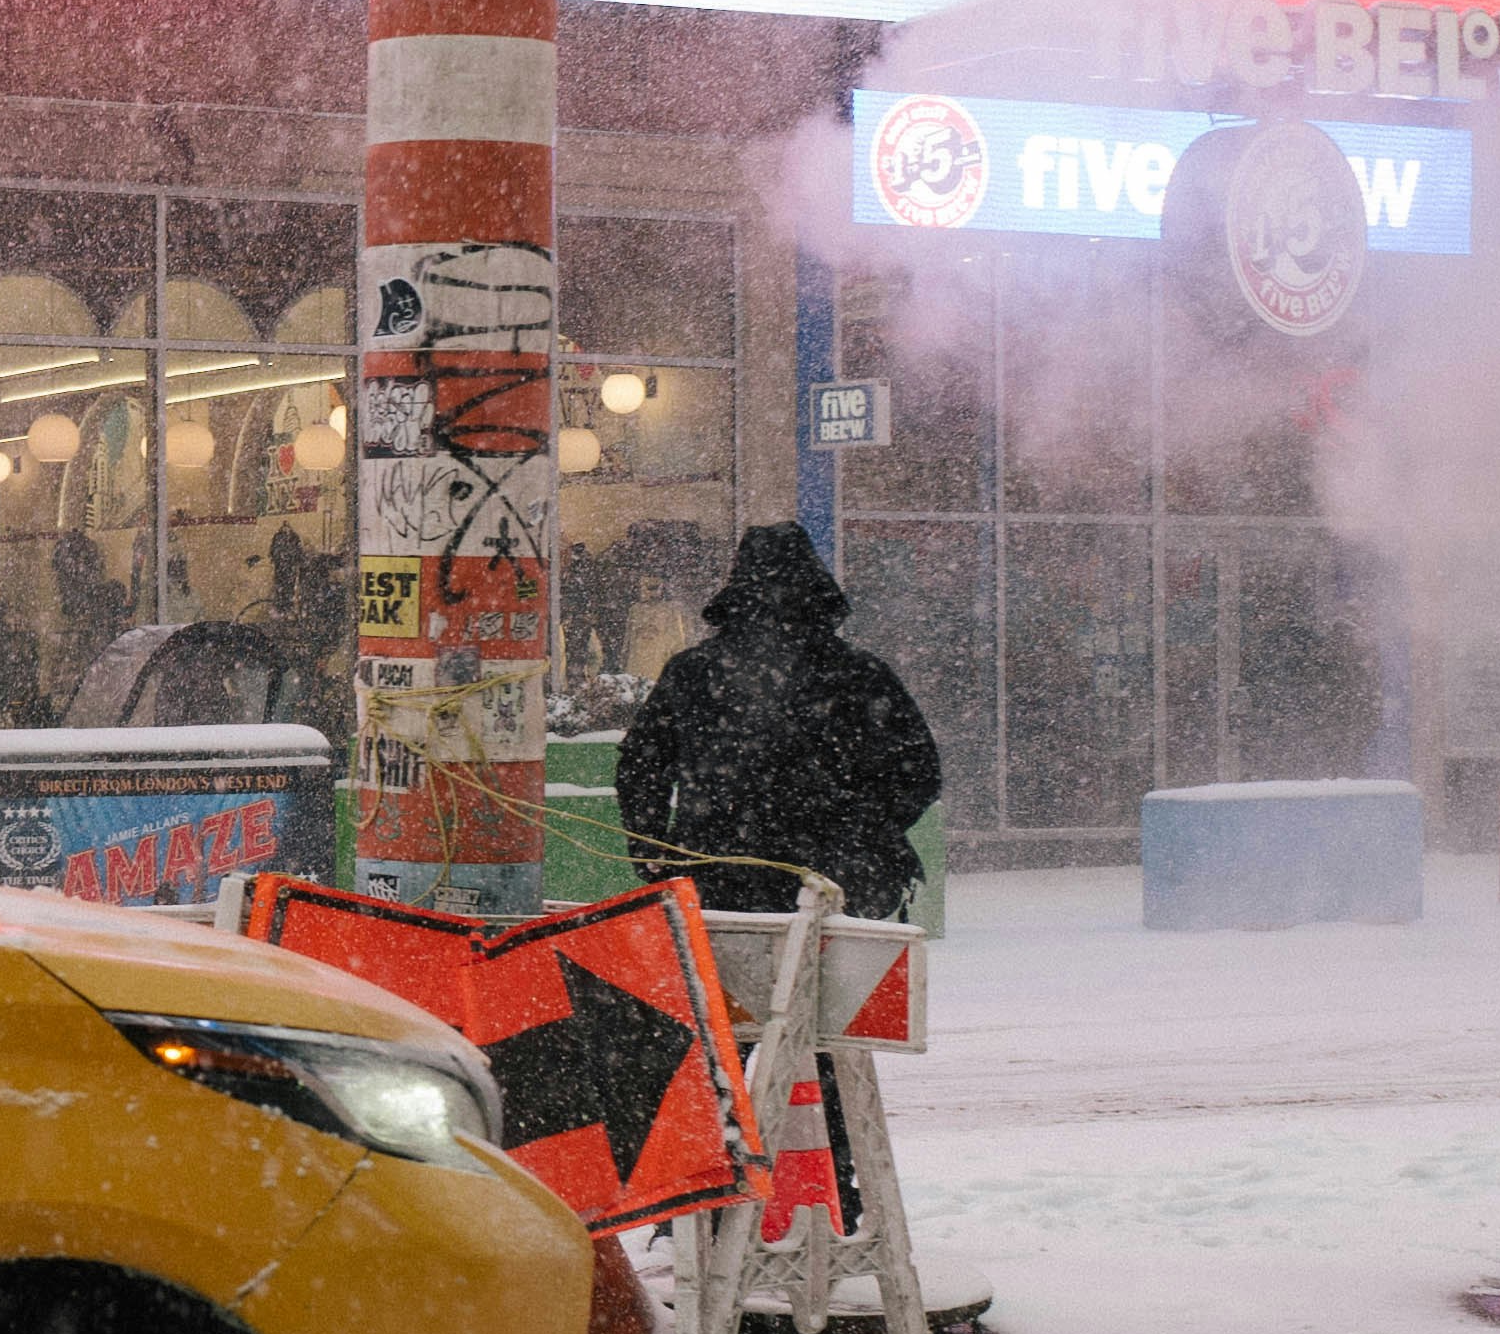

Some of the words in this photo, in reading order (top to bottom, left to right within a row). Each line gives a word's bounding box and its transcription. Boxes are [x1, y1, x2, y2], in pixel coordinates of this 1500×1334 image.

[1017, 134, 1176, 216] five
[822, 388, 866, 419] five
[361, 571, 418, 598] EST
[40, 779, 90, 794] DIRECT
[93, 778, 135, 793] FROM
[136, 776, 210, 792] LONDON'S
[214, 776, 255, 791] WEST
[258, 775, 287, 789] END
[104, 828, 140, 847] JAMIE
[142, 812, 191, 836] ALLAN'S
[63, 798, 278, 907] AMAZE
